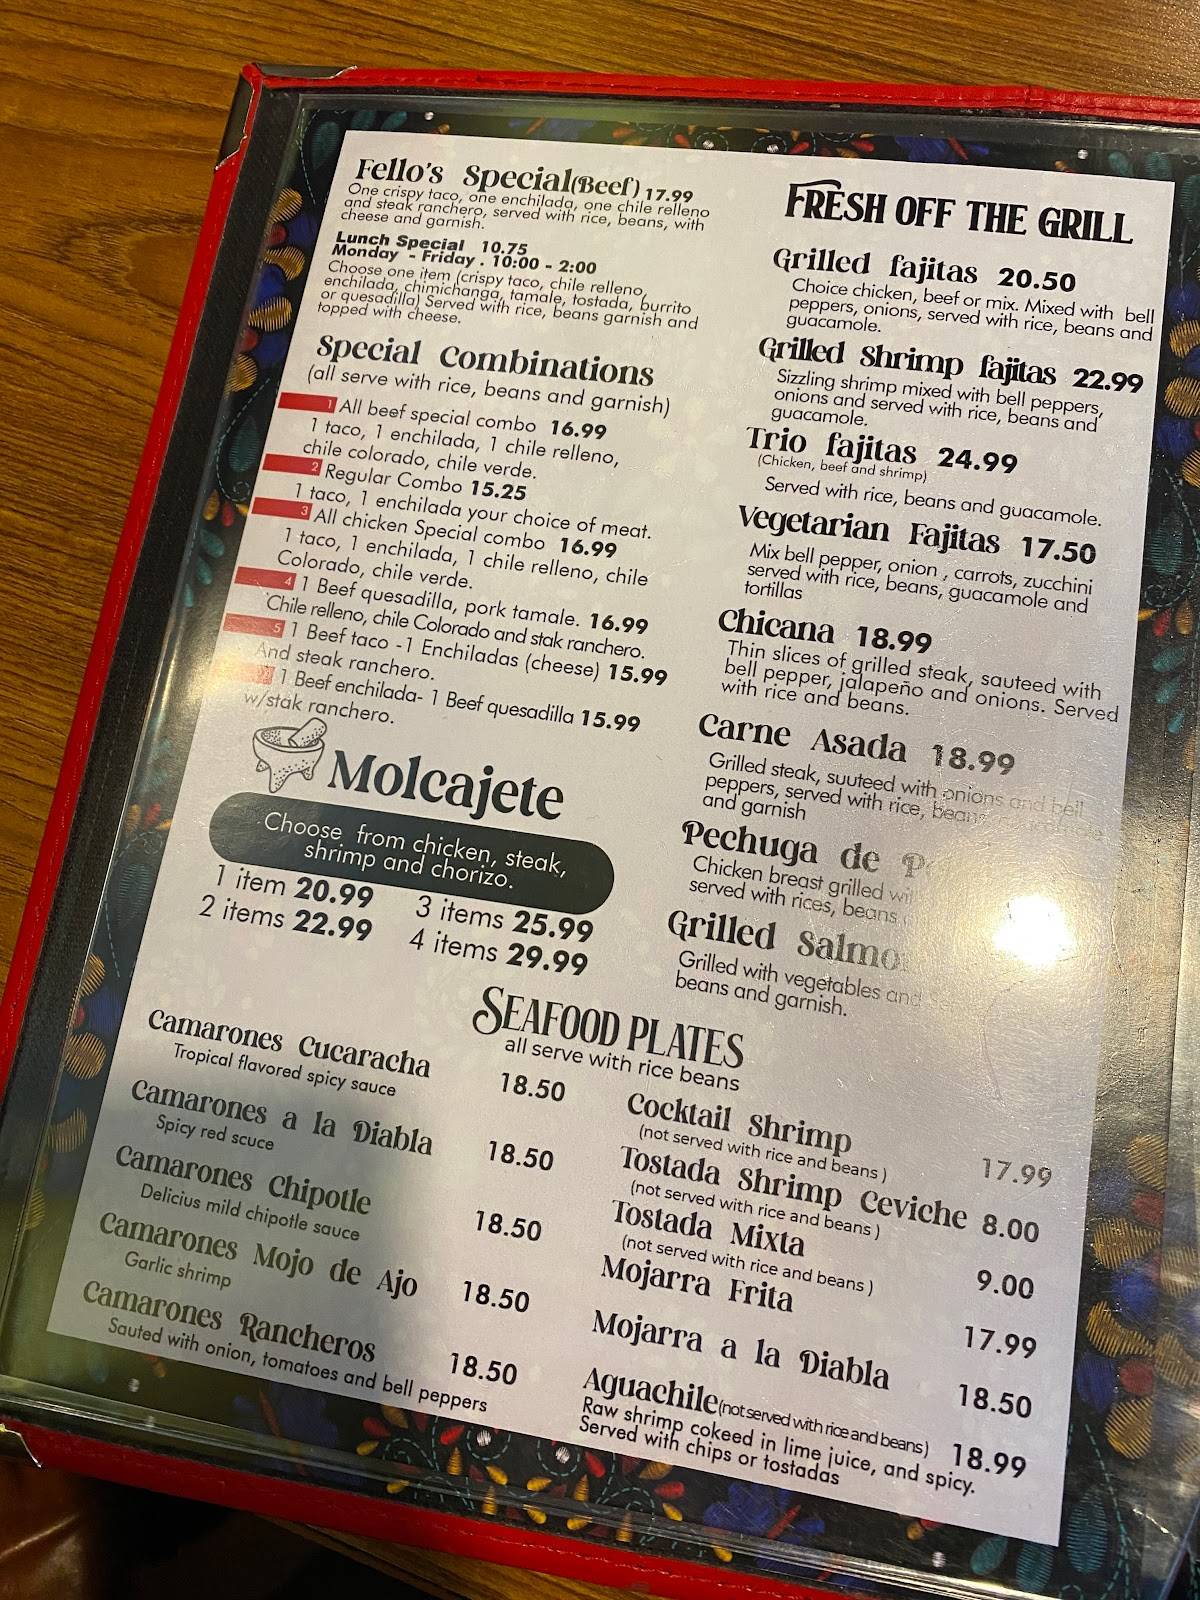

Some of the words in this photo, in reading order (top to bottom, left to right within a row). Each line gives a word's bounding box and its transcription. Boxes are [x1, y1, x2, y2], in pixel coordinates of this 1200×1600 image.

[347, 182, 379, 196] One
[383, 185, 425, 203] crispy
[428, 188, 463, 206] taco,
[468, 194, 497, 204] one
[501, 193, 578, 214] enchilada,
[583, 201, 612, 212] one
[617, 199, 653, 214] chile
[657, 202, 710, 218] relleno
[354, 157, 444, 184] Fello's
[645, 187, 694, 203] 17.99
[340, 205, 389, 223] cheese
[393, 210, 423, 225] and
[425, 215, 487, 230] garnish.
[784, 178, 888, 224] FRESH
[895, 195, 957, 229] OFF
[965, 200, 1029, 236] THE
[1038, 206, 1134, 245] GRILL
[335, 230, 390, 246] Lunch
[395, 234, 466, 255] Special
[482, 240, 528, 256] 10.75
[772, 247, 871, 275] Grilled
[888, 254, 978, 285] fajitas
[996, 267, 1077, 293] 20.50
[317, 300, 369, 318] topped
[373, 304, 402, 319] with
[407, 306, 462, 325] cheese.
[316, 334, 422, 365] Special
[439, 345, 654, 387] Combinations
[758, 336, 846, 365] Grilled
[859, 344, 965, 381] Shrimp
[978, 354, 1057, 387] fajitas
[1071, 367, 1144, 394] 22.99
[307, 363, 336, 385] (all
[340, 371, 389, 386] serve
[394, 372, 431, 391] with
[437, 376, 476, 399] rice,
[483, 378, 541, 402] beans
[547, 388, 586, 406] and
[590, 394, 670, 420] garnish)
[776, 368, 836, 392] Sizzling
[840, 373, 898, 397] shrimp
[902, 381, 953, 400] mixed
[956, 386, 990, 403] with
[995, 388, 1026, 407] bell
[1030, 397, 1104, 421] peppers,
[338, 397, 363, 415] All
[367, 399, 408, 420] beef
[409, 408, 472, 427] special
[475, 414, 537, 433] combo
[551, 419, 608, 440] 16.99
[302, 438, 342, 457] chile
[347, 444, 430, 471] colorado,
[436, 452, 478, 472] chile
[483, 460, 537, 480] verde.
[746, 426, 807, 454] Trio
[825, 431, 917, 469] fajitas
[936, 446, 1018, 474] 24.99
[757, 453, 815, 472] (Chicken,
[819, 458, 848, 473] beef
[851, 460, 876, 476] and
[879, 465, 928, 485] shrimp)
[324, 463, 393, 486] Regular
[397, 471, 463, 494] Combo
[471, 479, 527, 501] 15.25
[312, 507, 338, 525] All
[342, 510, 408, 534] chicken
[413, 519, 479, 543] Special
[483, 531, 546, 551] combo
[560, 536, 618, 559] 16.99
[739, 504, 890, 542] Vegetarian
[908, 522, 1000, 555] Fajitas
[1021, 536, 1097, 565] 17.50
[277, 549, 367, 579] Colorado,
[372, 561, 413, 581] chile
[419, 570, 473, 590] verde.
[316, 577, 358, 598] Beef
[360, 588, 458, 615] quesadilla,
[464, 599, 507, 618] pork
[512, 599, 580, 627] tamale.
[590, 612, 649, 635] 16.99
[718, 607, 835, 644] Chicana
[856, 625, 933, 654] 18.99
[698, 713, 791, 748] Carne
[809, 728, 907, 763] Asada
[935, 744, 1015, 776] 18.99
[326, 749, 564, 821] Molcajete
[264, 808, 343, 840] Choose
[356, 823, 406, 851] from
[412, 832, 497, 869] chicken,
[504, 850, 568, 879] steak,
[303, 838, 376, 872] shrimp
[383, 853, 426, 875] and
[430, 857, 514, 889] chorizo.
[681, 820, 818, 867] Pechuga
[840, 842, 881, 873] de
[235, 867, 286, 896] item
[293, 876, 374, 909] 20.99
[197, 894, 216, 918] 2
[222, 897, 286, 929] items
[291, 909, 373, 942] 22.99
[415, 895, 432, 919] 3
[440, 898, 504, 930] items
[511, 910, 594, 943] 25.99
[408, 927, 425, 951] 4
[433, 930, 498, 963] items
[505, 942, 589, 976] 29.99
[672, 969, 729, 997] beans
[733, 980, 771, 1004] and
[774, 987, 847, 1017] garnish.
[148, 1009, 283, 1052] Camarones
[298, 1035, 431, 1079] Cucaracha
[471, 985, 620, 1047] SEAFOOD
[626, 1015, 744, 1069] PLATES
[174, 1042, 234, 1068] Tropical
[237, 1053, 303, 1081] flavored
[306, 1069, 348, 1094] spicy
[350, 1079, 397, 1097] sauce
[502, 1072, 566, 1102] 18.50
[504, 1036, 528, 1055] all
[531, 1043, 584, 1064] serve
[589, 1052, 632, 1073] with
[638, 1059, 674, 1080] rice
[679, 1064, 740, 1092] beans
[627, 1092, 732, 1132] Cocktail
[747, 1113, 852, 1160] Shrimp
[115, 1145, 254, 1192] Camarones
[268, 1174, 372, 1216] Chipotle
[617, 1145, 720, 1186] Tostada
[737, 1167, 843, 1212] Shrimp
[860, 1190, 968, 1230] Ceviche
[981, 1213, 1040, 1243] 8.00
[983, 1153, 1056, 1188] 17.99
[476, 1210, 542, 1242] 18.50
[611, 1199, 713, 1241] Tostada
[729, 1221, 805, 1258] Mixta
[600, 1254, 711, 1297] Mojarra
[728, 1278, 794, 1314] Frita
[976, 1269, 1035, 1300] 9.00
[82, 1280, 223, 1331] Camarones
[239, 1312, 376, 1363] Rancheros
[966, 1325, 1037, 1359] 17.99
[451, 1352, 518, 1386] 18.50
[578, 1409, 639, 1443] Served
[644, 1423, 682, 1451] with
[685, 1431, 734, 1464] chips
[738, 1453, 758, 1468] or
[763, 1447, 842, 1485] tostadas
